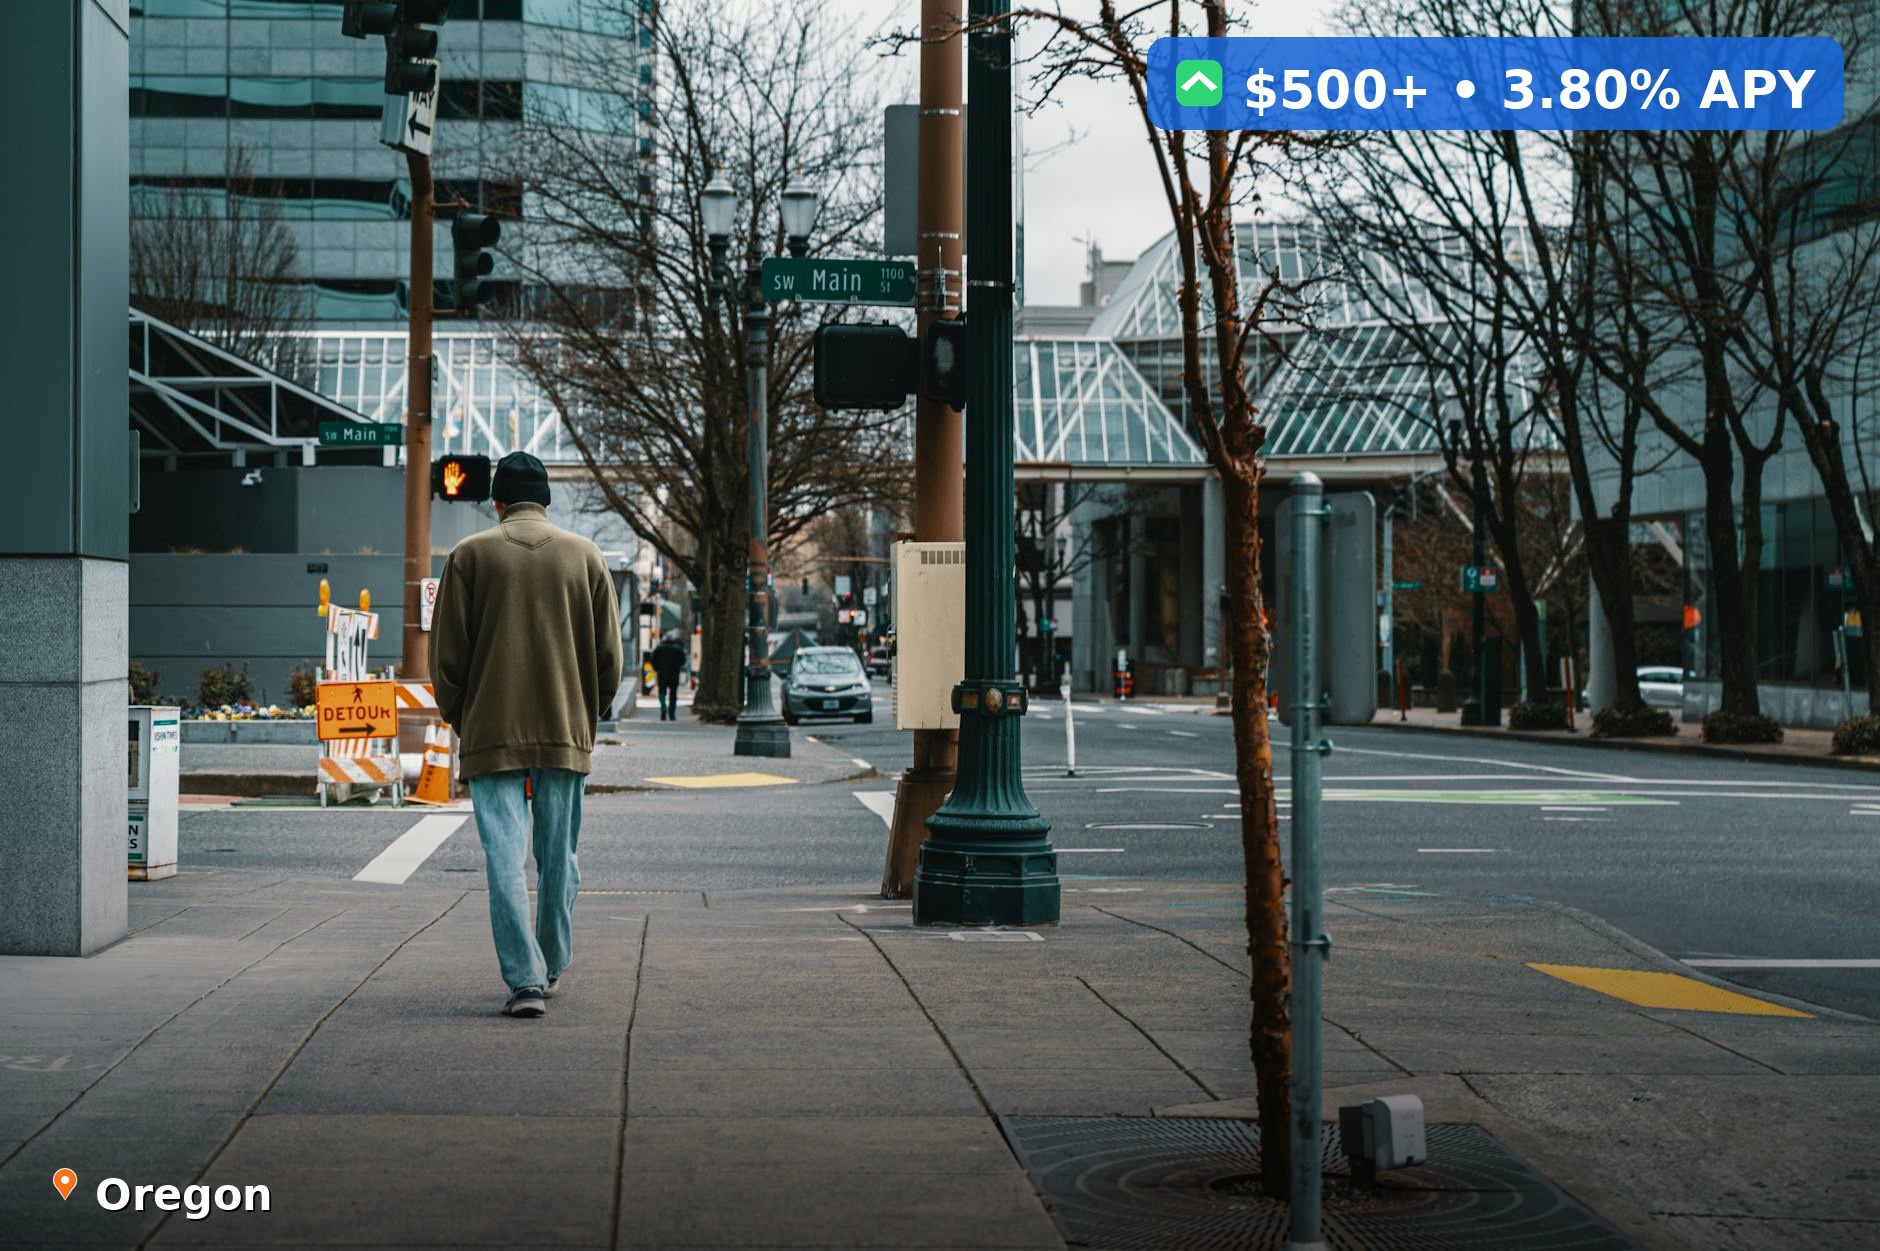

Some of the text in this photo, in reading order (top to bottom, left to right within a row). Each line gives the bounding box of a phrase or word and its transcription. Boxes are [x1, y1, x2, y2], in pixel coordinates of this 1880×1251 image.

[773, 267, 862, 292] SW Main
[880, 267, 905, 280] 1100
[880, 281, 891, 293] St
[343, 427, 377, 441] Main
[324, 705, 390, 722] DETOUR
